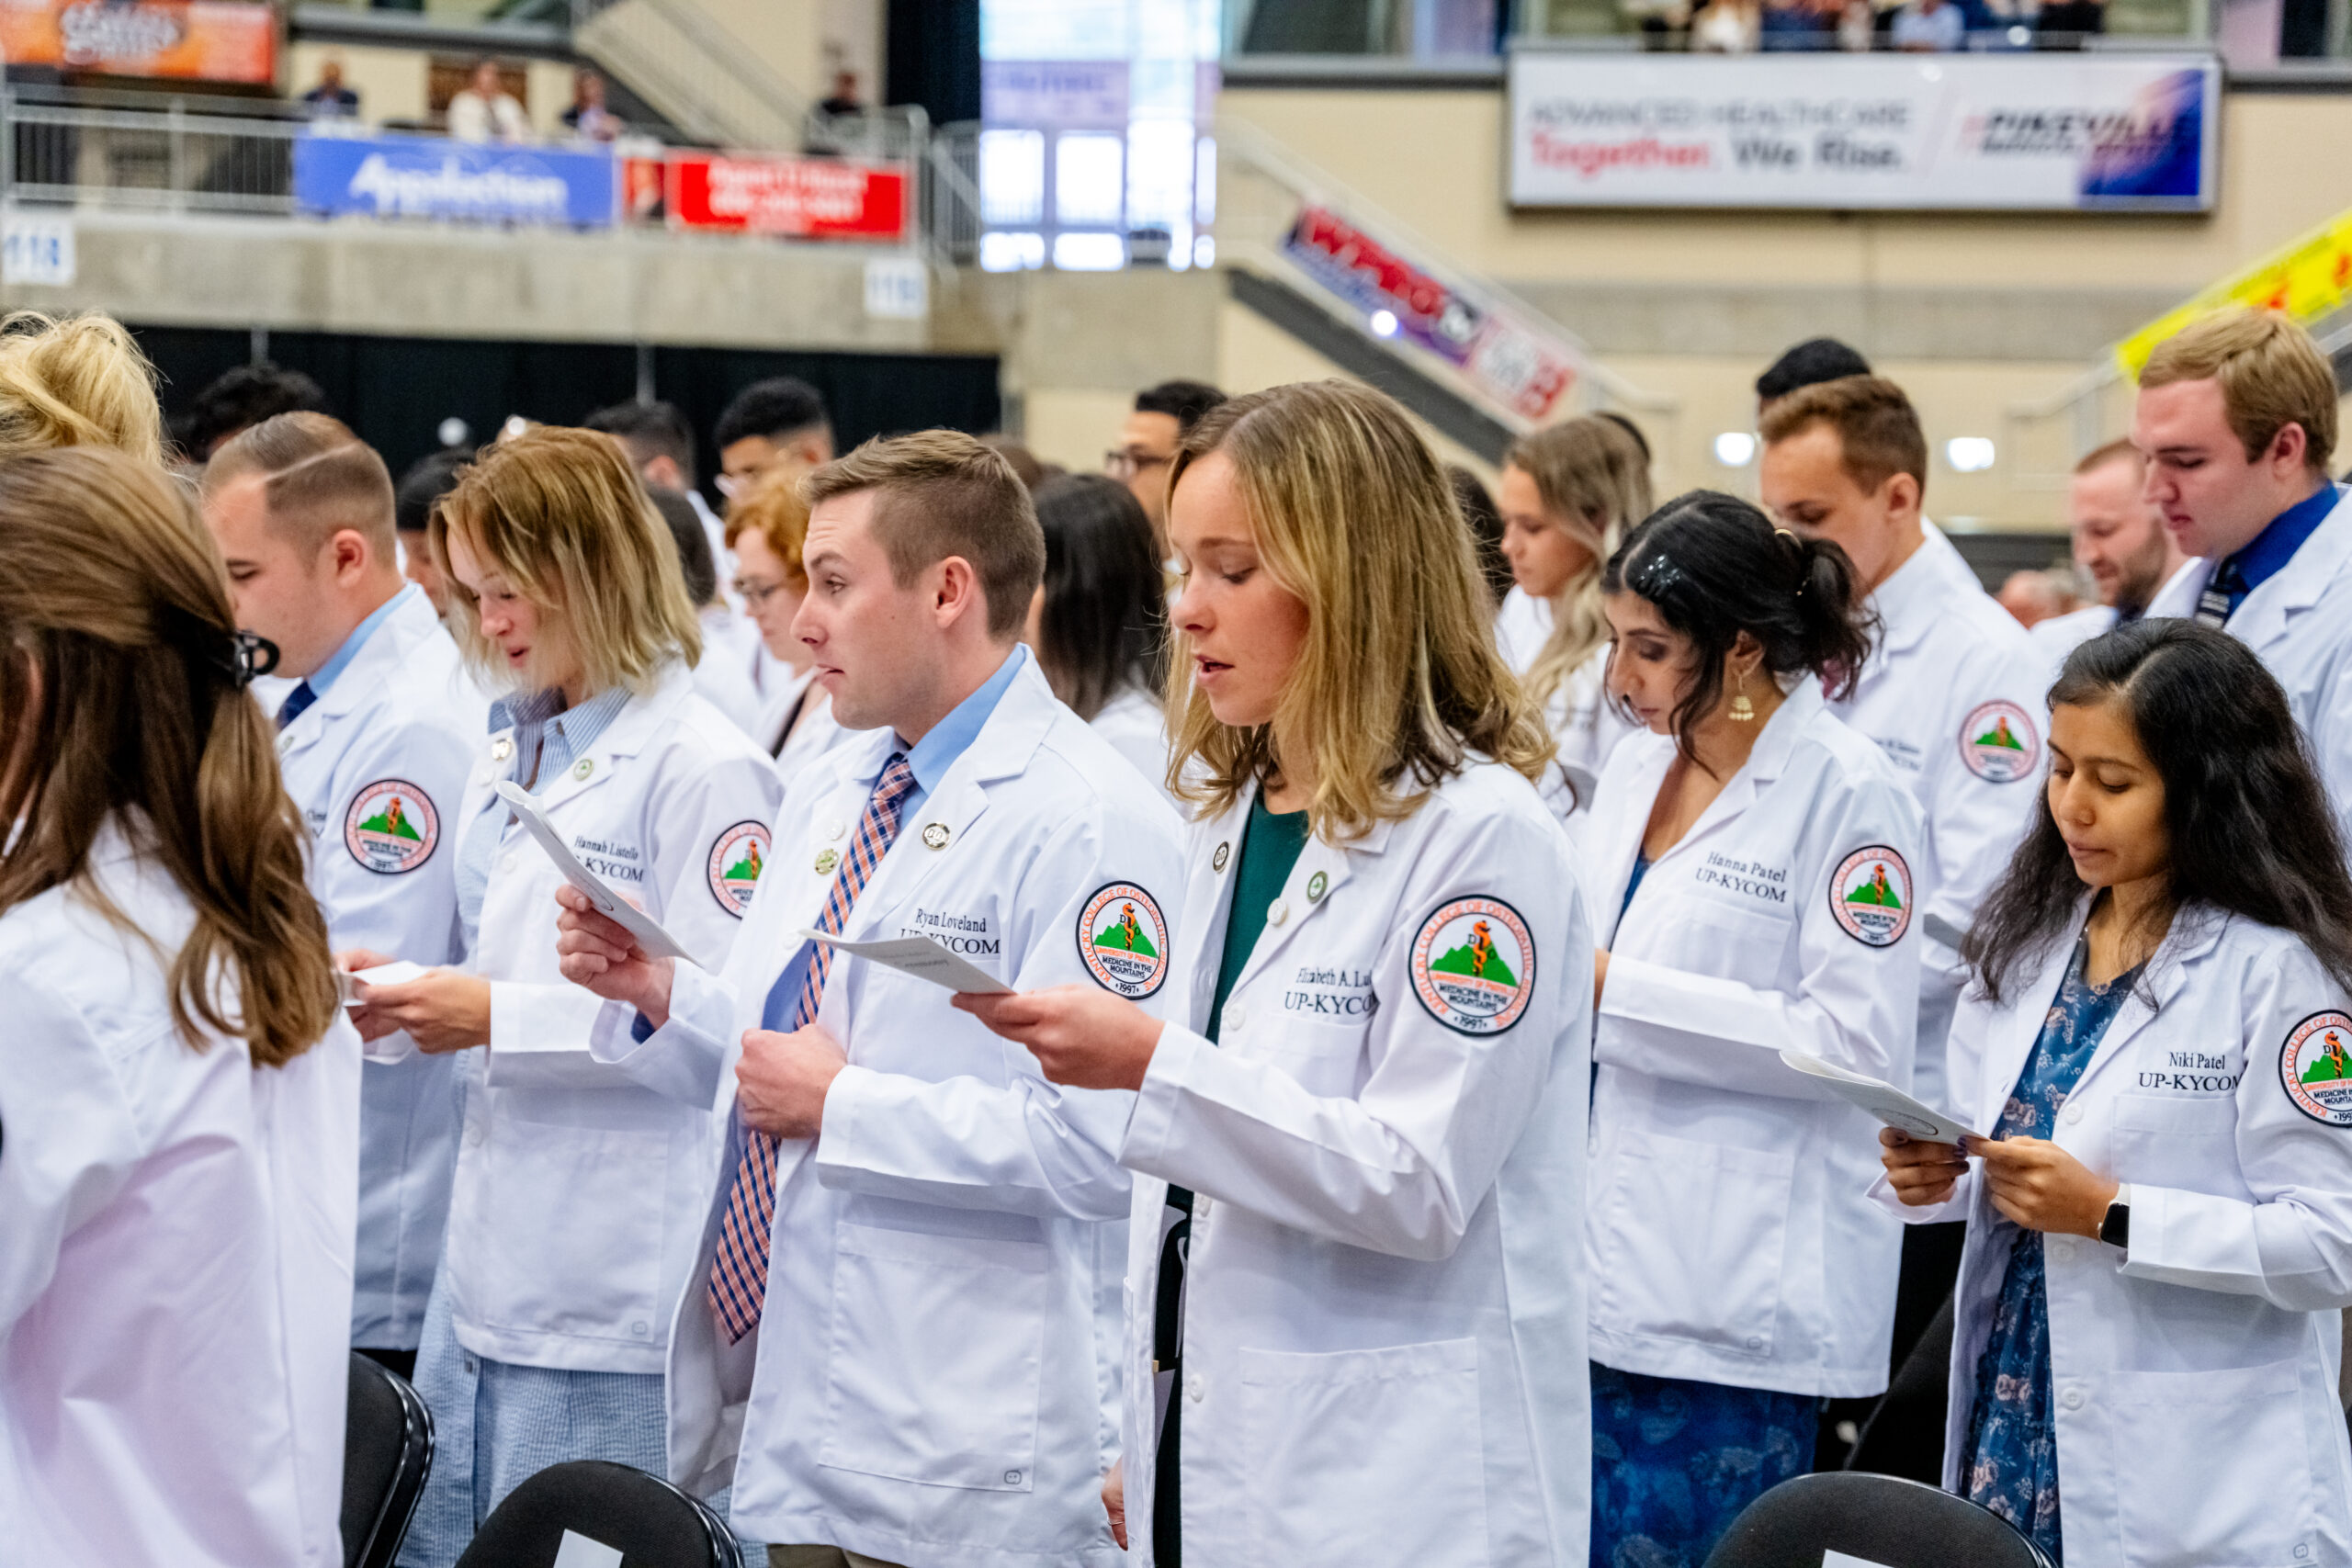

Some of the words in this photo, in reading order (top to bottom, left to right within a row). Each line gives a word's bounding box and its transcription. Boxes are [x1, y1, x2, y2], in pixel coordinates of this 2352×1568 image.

[574, 836, 607, 853] Hannah
[1707, 852, 1747, 873] Hanna
[1750, 862, 1787, 883] Patel
[1116, 887, 1128, 897] OF
[1695, 867, 1787, 903] UP-KYCOM
[1083, 888, 1116, 928] COLLEGE
[915, 908, 939, 928] Ryan
[941, 912, 986, 932] Loveland
[1081, 929, 1112, 983] KENTUCKY
[1102, 956, 1132, 967] MEDICINE
[1141, 964, 1152, 974] THE
[1110, 964, 1146, 978] MOUNTAINS
[1338, 970, 1351, 987] A.
[1119, 983, 1136, 994] 1997
[2313, 1016, 2327, 1028] OF
[2285, 1022, 2313, 1067] COLLEGE
[2169, 1052, 2194, 1068] Niki
[2197, 1053, 2225, 1070] Patel
[2286, 1071, 2328, 1118] KENTUCKY
[2313, 1089, 2347, 1099] MEDICINE
[2324, 1096, 2352, 1104] MOUNTA
